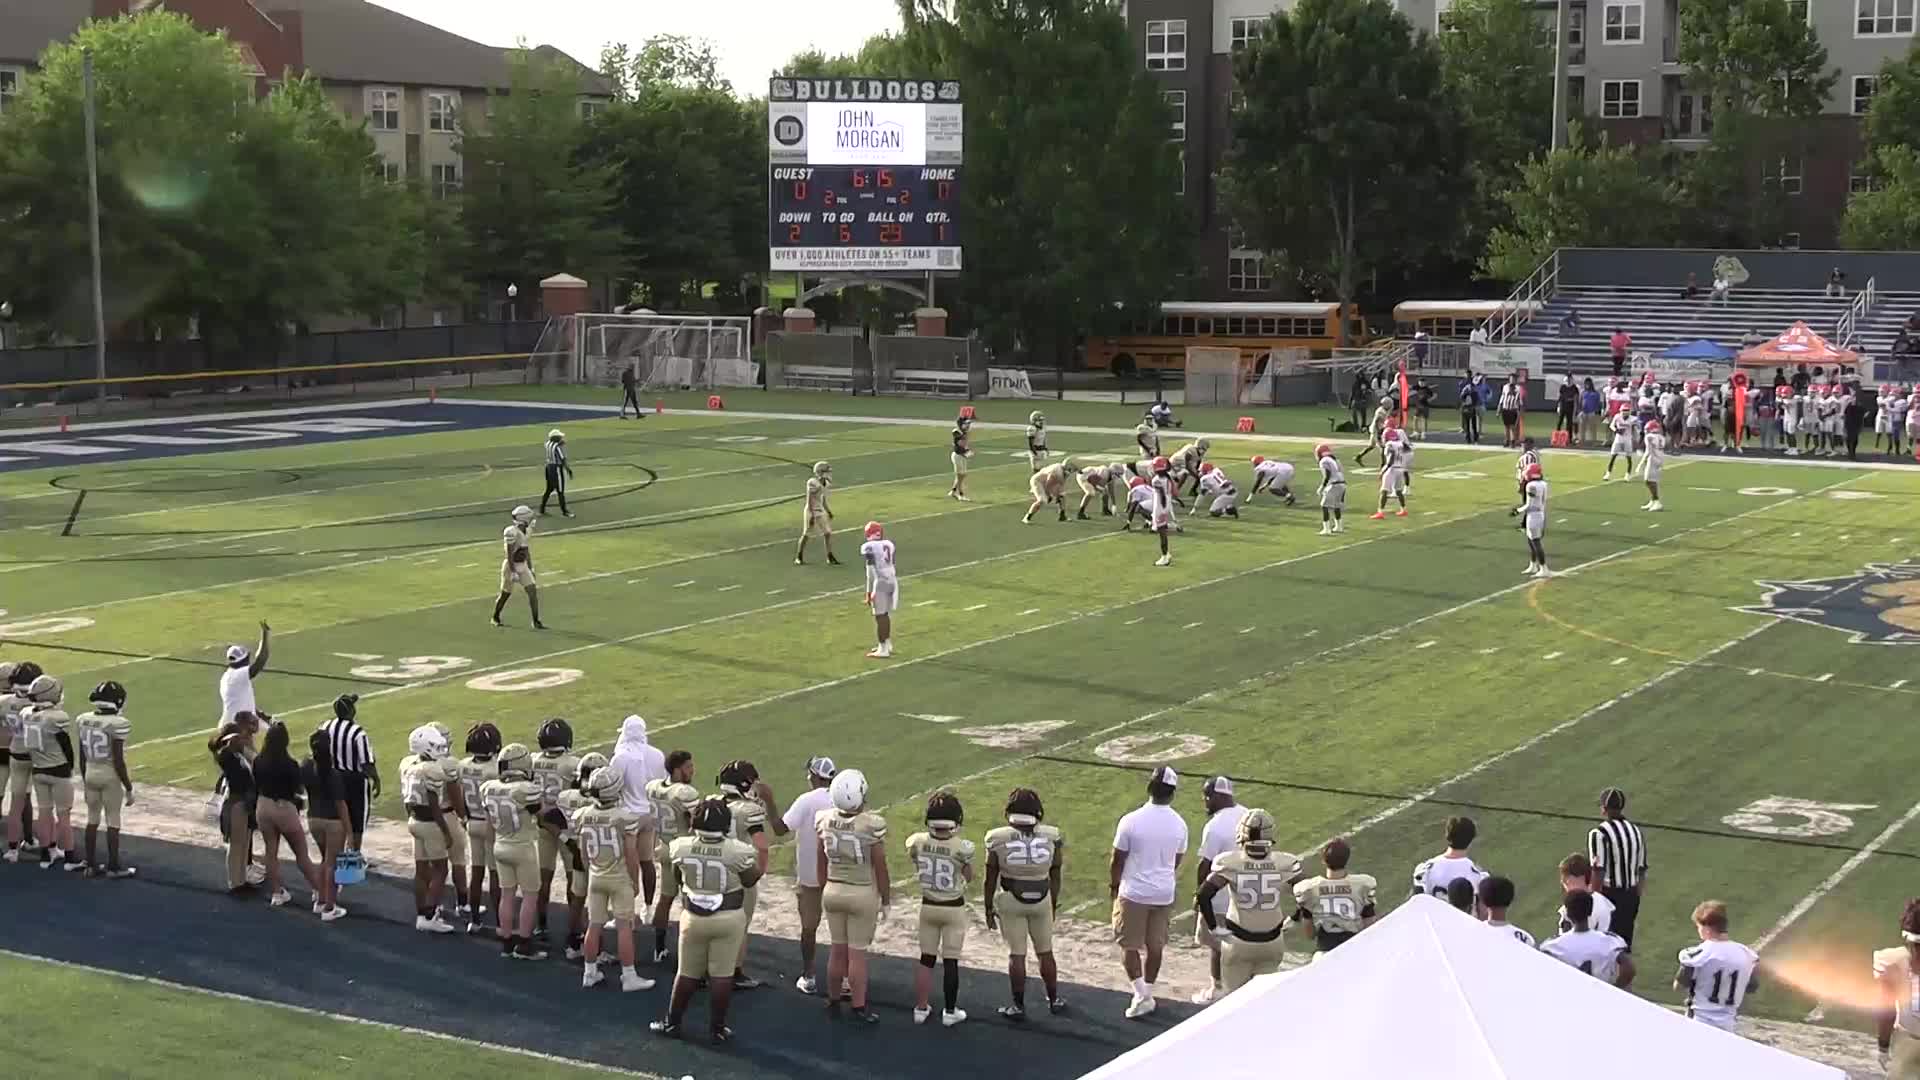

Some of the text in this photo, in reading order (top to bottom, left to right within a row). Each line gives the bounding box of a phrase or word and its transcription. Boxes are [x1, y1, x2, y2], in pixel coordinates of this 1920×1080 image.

[796, 80, 936, 100] BULLDOGS
[837, 110, 874, 128] JOHN
[836, 130, 900, 148] MORGAN
[774, 168, 814, 180] GUEST
[853, 169, 893, 188] 6:15
[921, 168, 956, 181] HOME
[794, 182, 806, 200] 0
[824, 190, 834, 205] 2
[899, 190, 911, 205] 2
[779, 212, 811, 223] DOWN
[822, 212, 855, 223] TO GO
[867, 212, 913, 223] BALL ON
[925, 212, 950, 223] QTR.
[789, 225, 800, 241] 2
[775, 251, 797, 260] OVER
[800, 251, 822, 261] 1,000
[825, 250, 866, 260] ATHLETES
[869, 250, 881, 259] ON
[903, 249, 931, 259] TEAMS
[681, 857, 728, 894] 77
[917, 855, 955, 890] 28
[1236, 873, 1282, 911] 55
[1709, 969, 1739, 1006] 11
